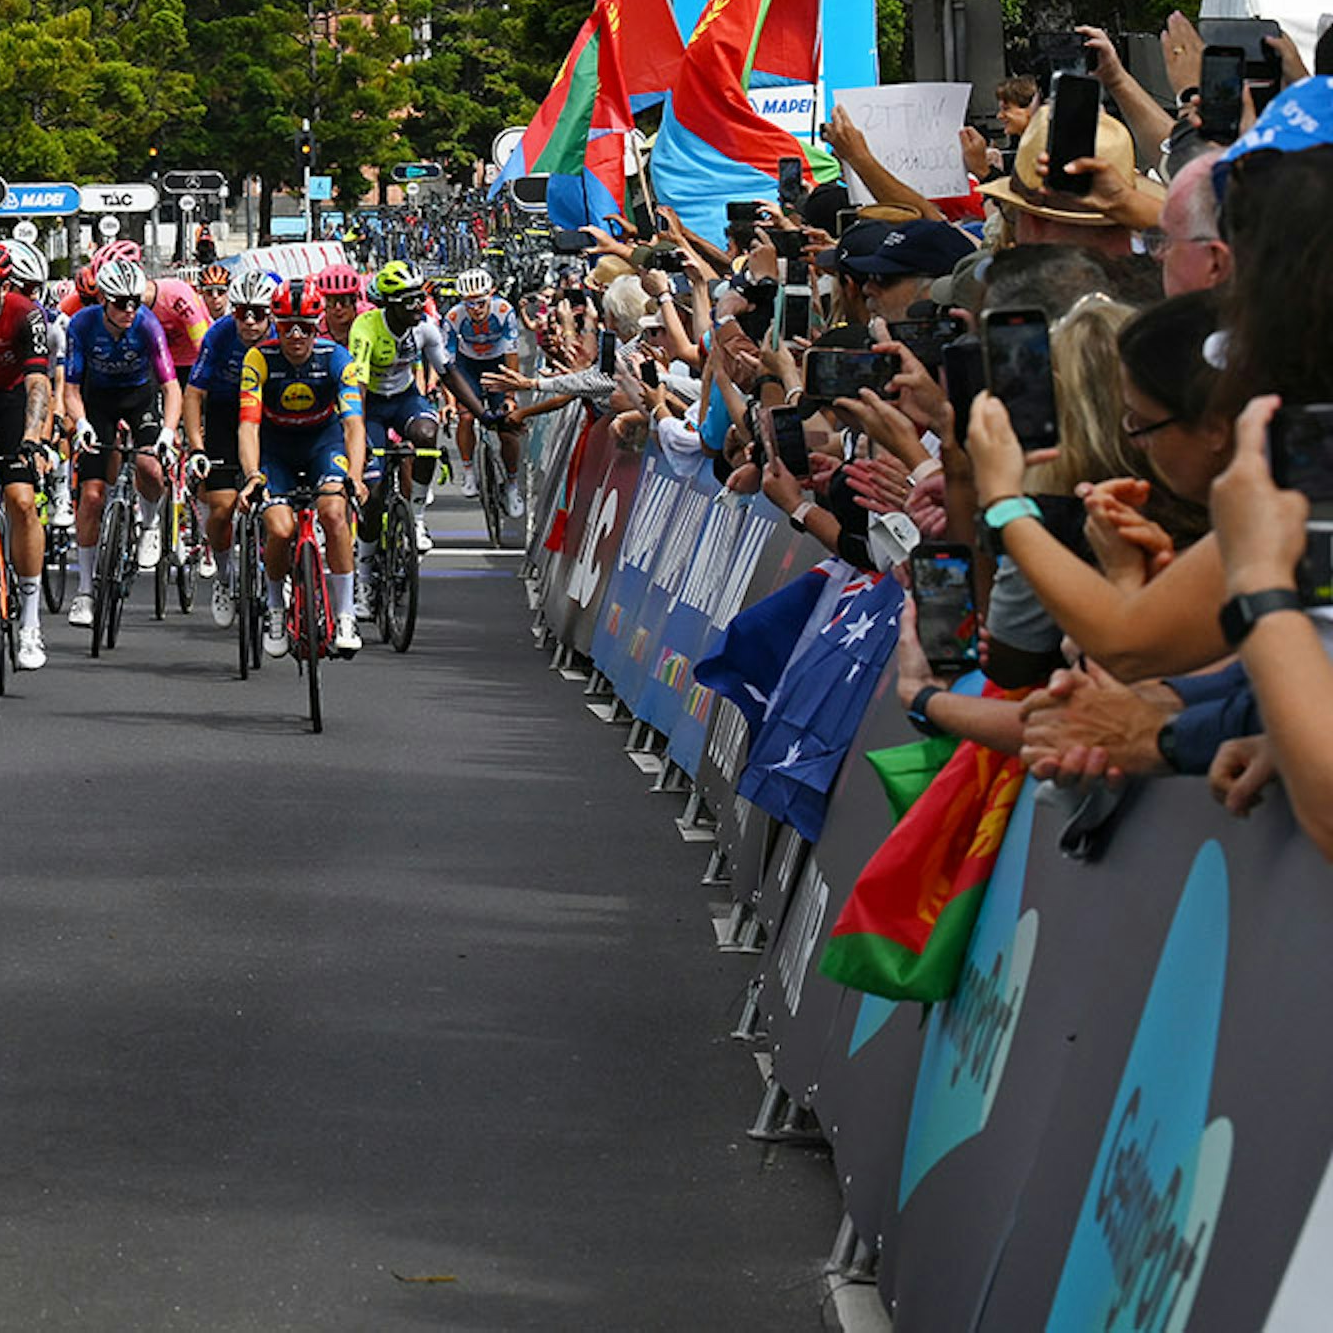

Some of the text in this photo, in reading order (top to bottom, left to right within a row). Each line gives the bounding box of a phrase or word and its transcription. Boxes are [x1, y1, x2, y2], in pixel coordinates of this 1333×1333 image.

[742, 99, 813, 115] MAPEI
[20, 192, 66, 207] MAPEI
[101, 191, 133, 206] TAC
[26, 308, 48, 355] INEOS
